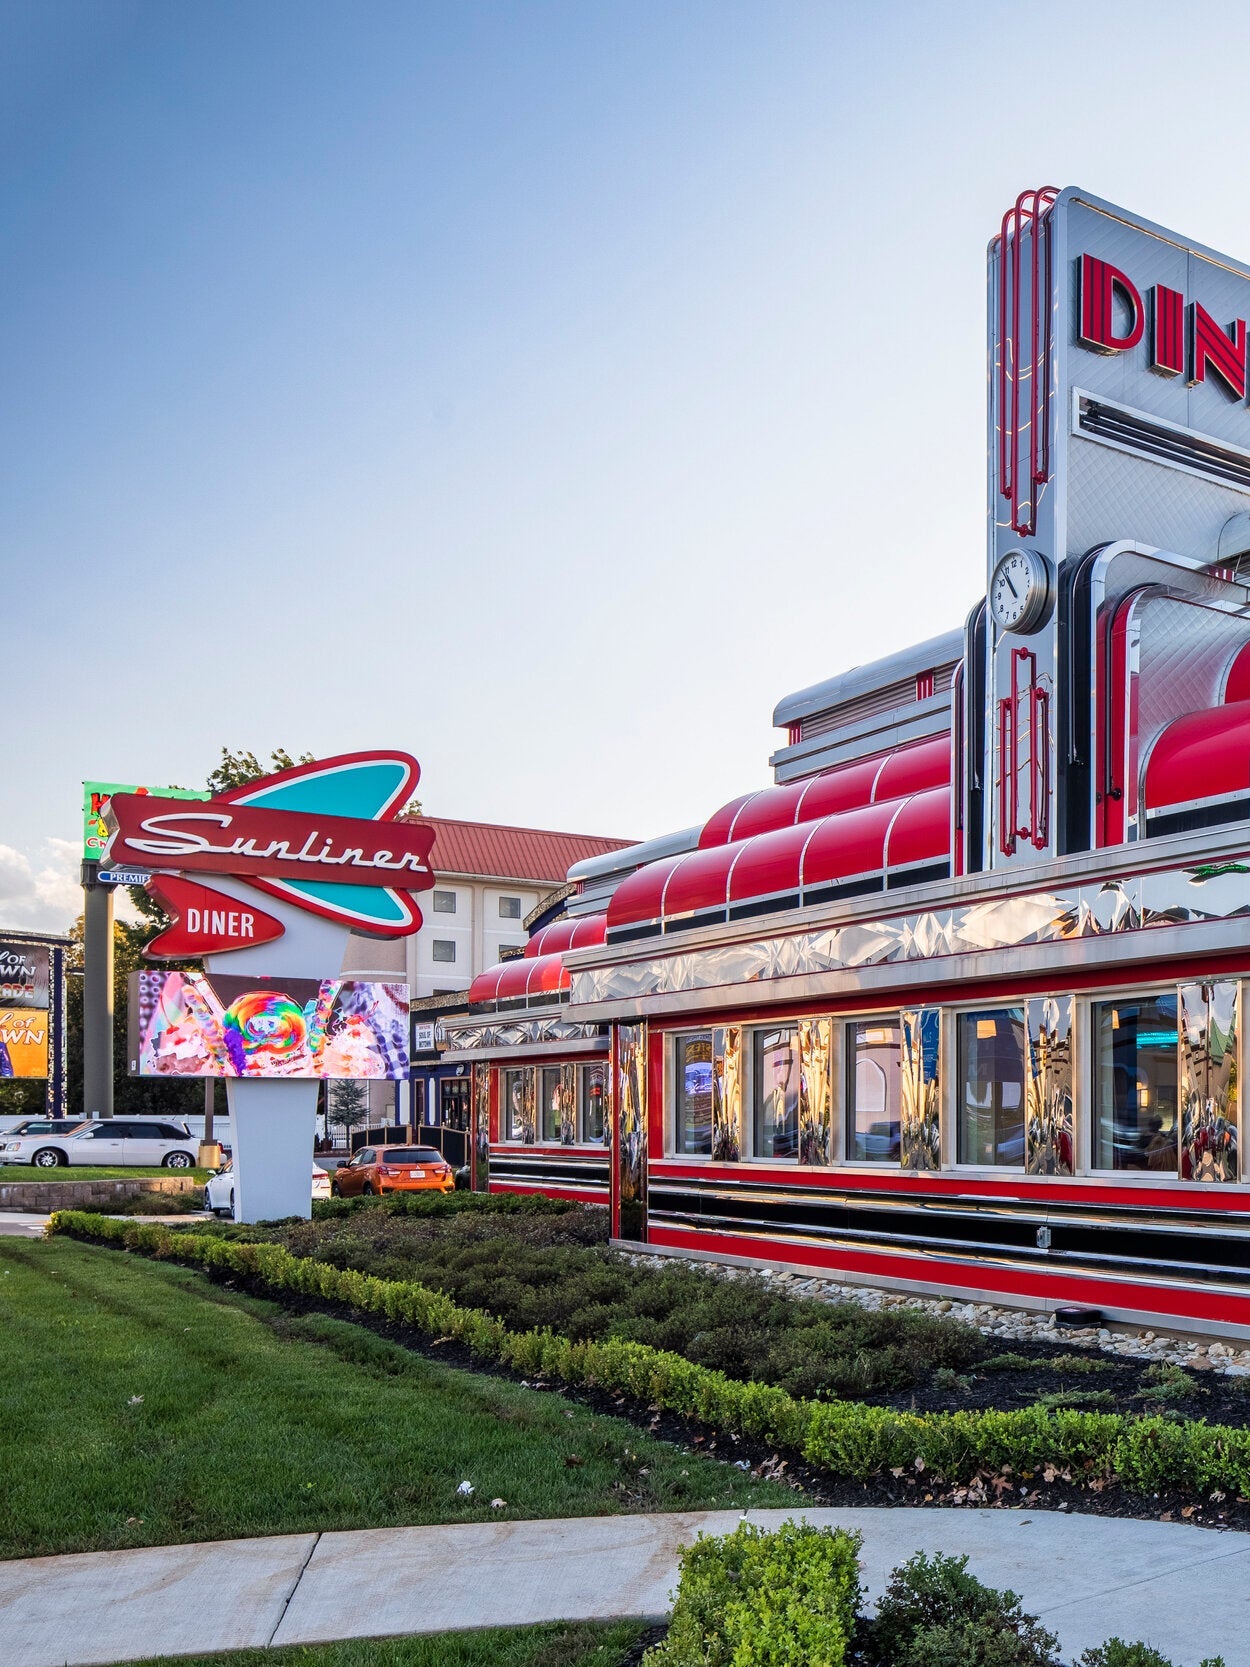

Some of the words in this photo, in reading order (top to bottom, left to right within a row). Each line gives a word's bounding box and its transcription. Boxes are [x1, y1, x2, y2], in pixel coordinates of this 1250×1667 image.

[124, 812, 429, 872] Sunliner
[186, 908, 255, 938] DINER
[7, 954, 27, 965] OF
[13, 1017, 36, 1029] of
